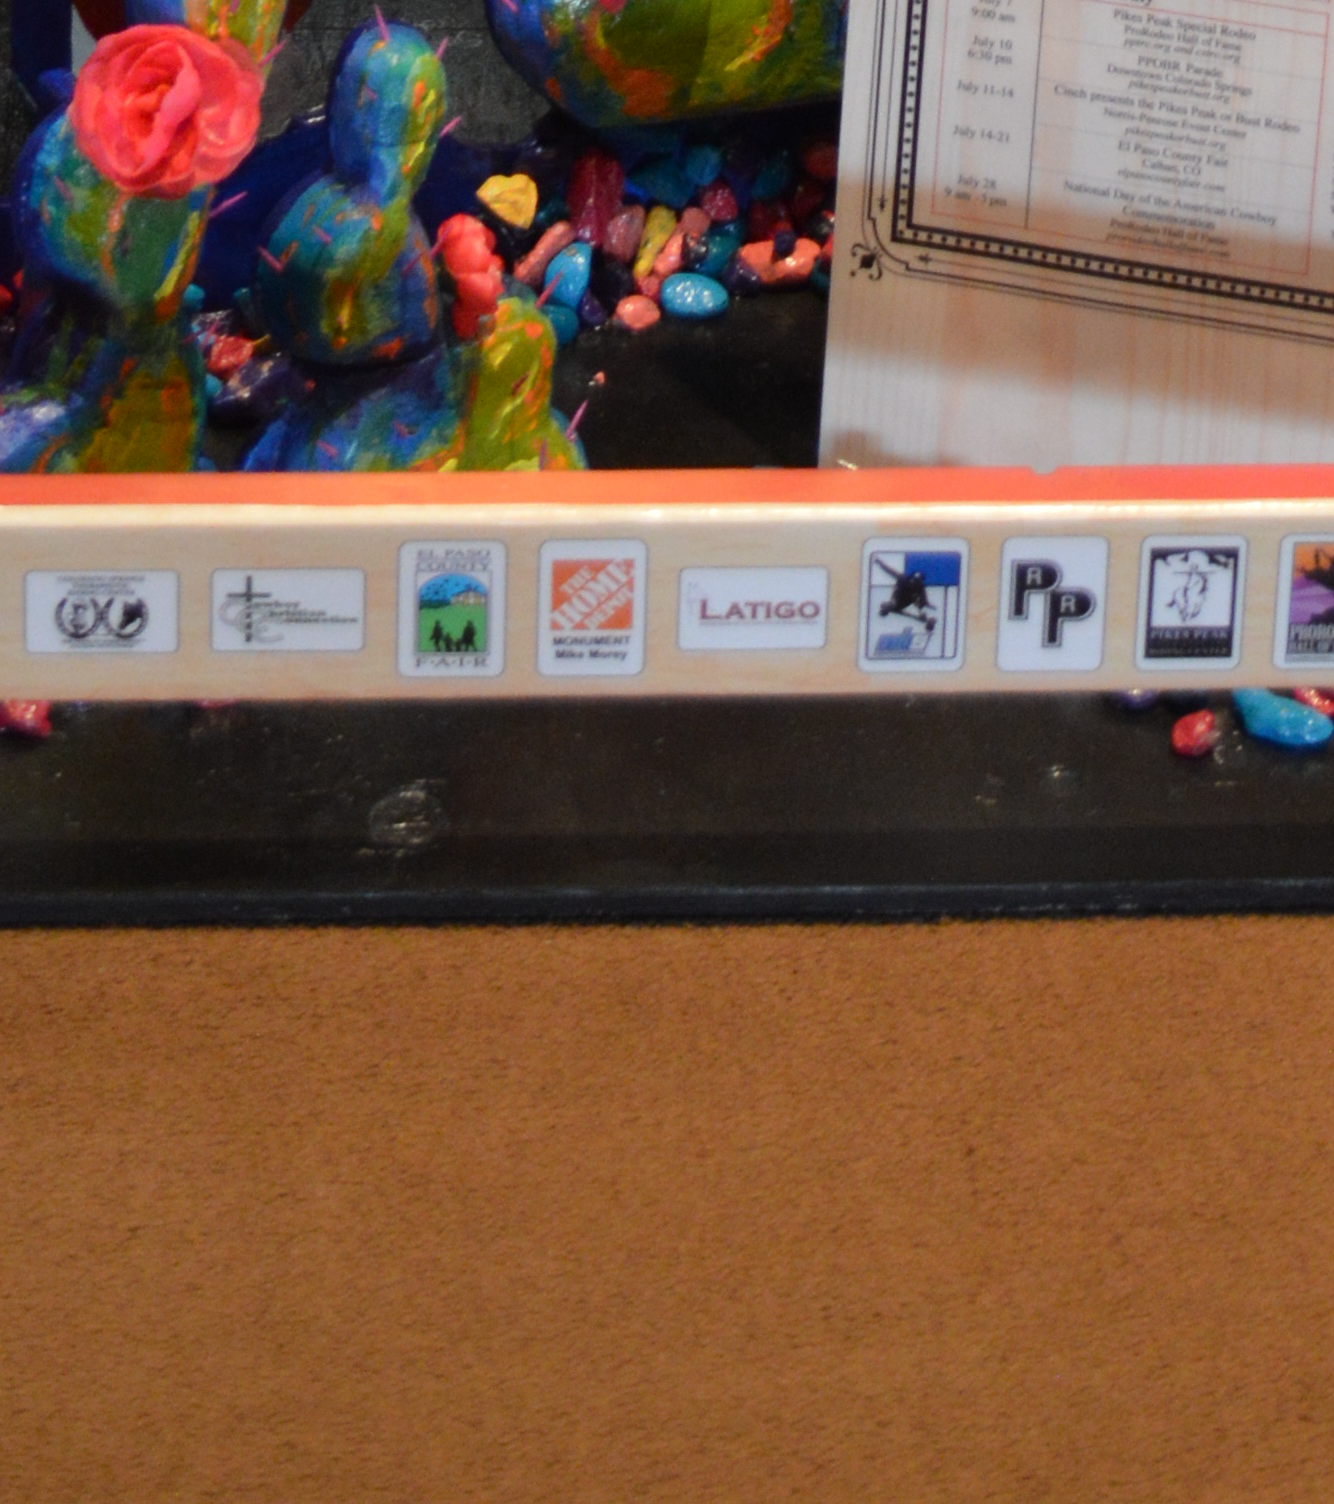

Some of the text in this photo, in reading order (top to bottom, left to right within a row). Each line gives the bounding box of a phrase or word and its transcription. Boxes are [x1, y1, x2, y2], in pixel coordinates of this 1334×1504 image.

[444, 548, 492, 559] PASO
[416, 562, 491, 572] COUNTY
[560, 564, 594, 595] THE
[551, 559, 635, 632] HOME
[552, 635, 631, 646] MONUMENT
[554, 649, 628, 662] Mike Morey
